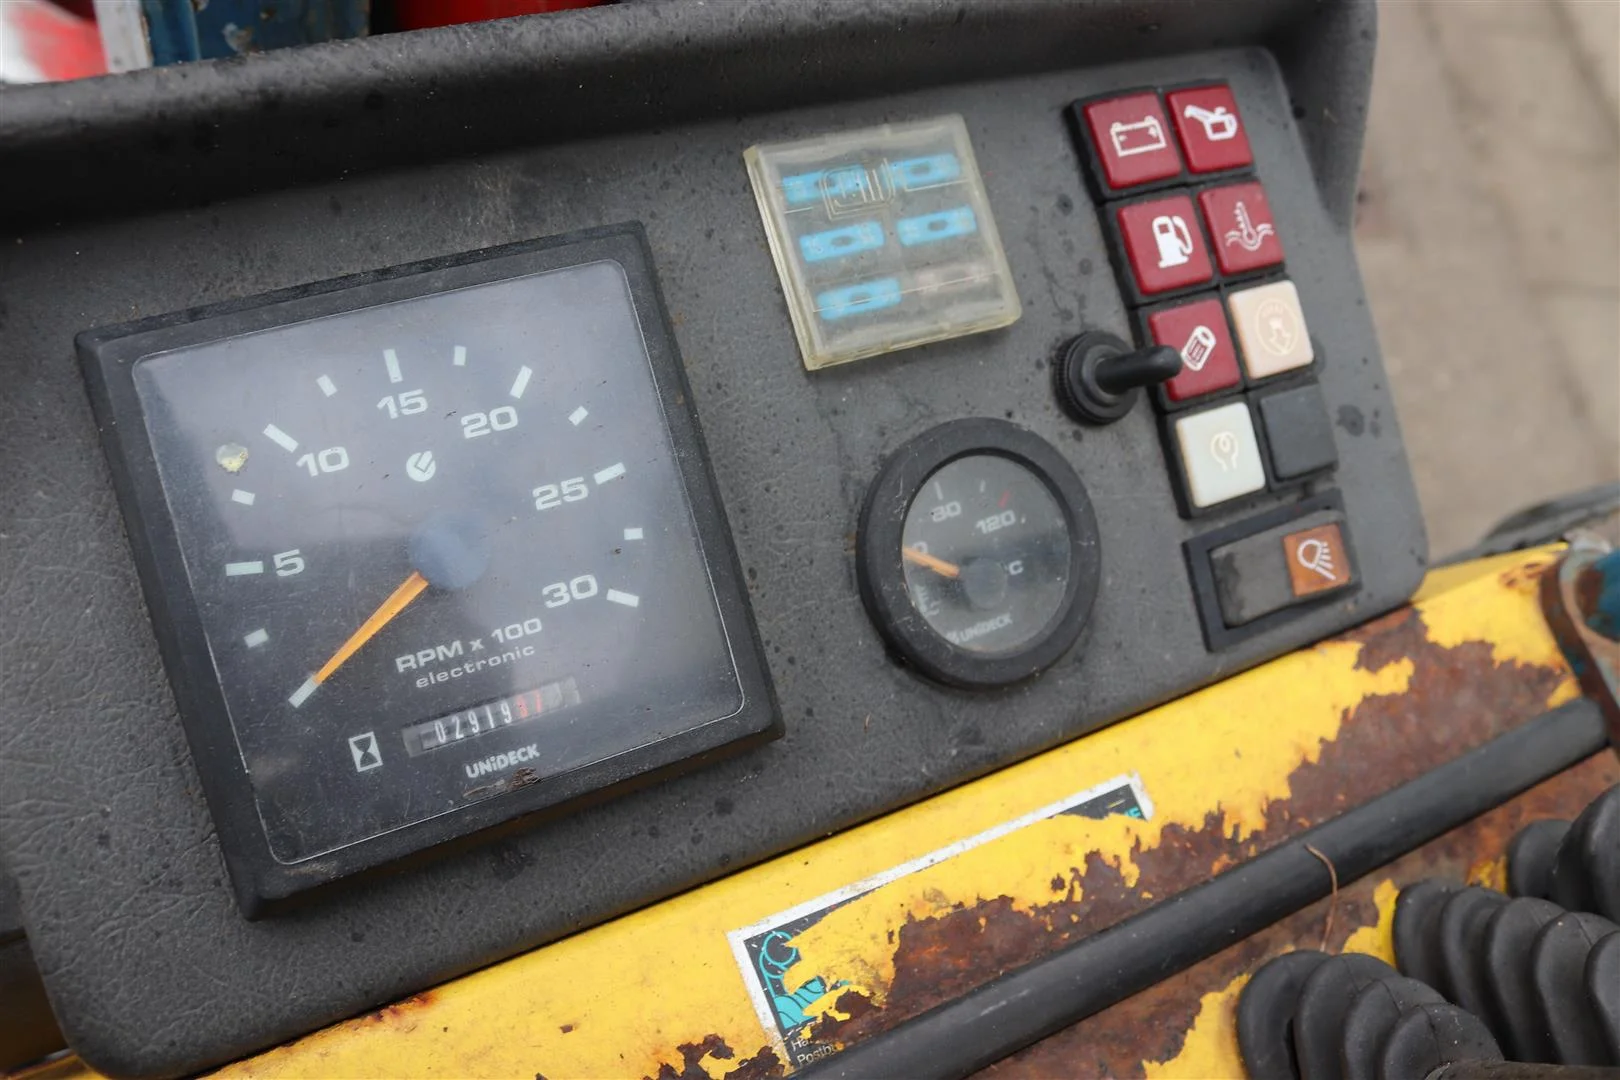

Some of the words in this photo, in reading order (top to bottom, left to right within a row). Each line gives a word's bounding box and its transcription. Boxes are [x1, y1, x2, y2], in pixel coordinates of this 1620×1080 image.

[377, 388, 429, 419] 15
[460, 406, 518, 439] 20
[296, 446, 350, 477] 10
[532, 477, 588, 510] 25
[932, 501, 962, 523] 80
[975, 509, 1016, 534] 120
[273, 549, 305, 577] 5
[542, 575, 598, 608] 30
[395, 640, 463, 673] RPM
[491, 618, 543, 643] 100
[415, 645, 536, 688] electronic
[790, 1036, 809, 1052] Ha
[797, 1043, 836, 1069] Postb
